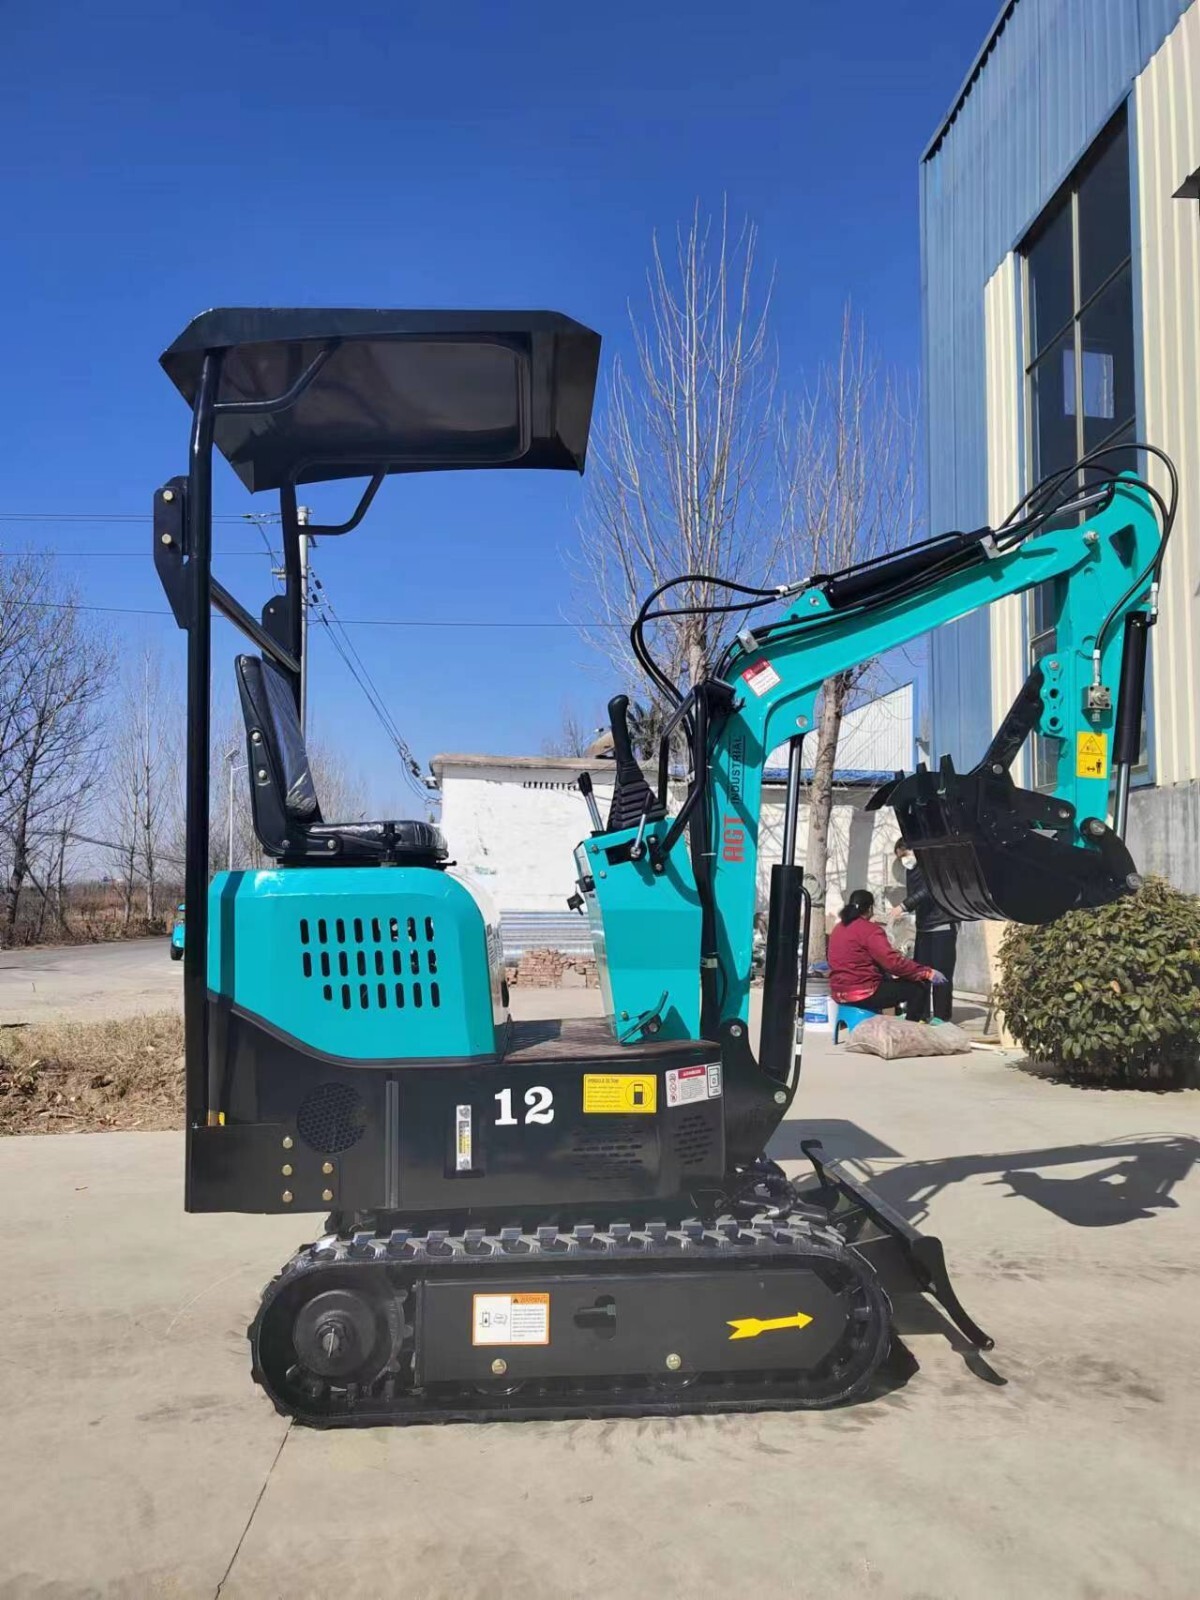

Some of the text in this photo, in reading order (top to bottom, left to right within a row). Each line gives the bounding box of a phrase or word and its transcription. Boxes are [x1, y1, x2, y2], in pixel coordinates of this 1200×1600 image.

[723, 736, 744, 862] AGT INDUSTRIAL
[494, 1086, 554, 1125] 12
